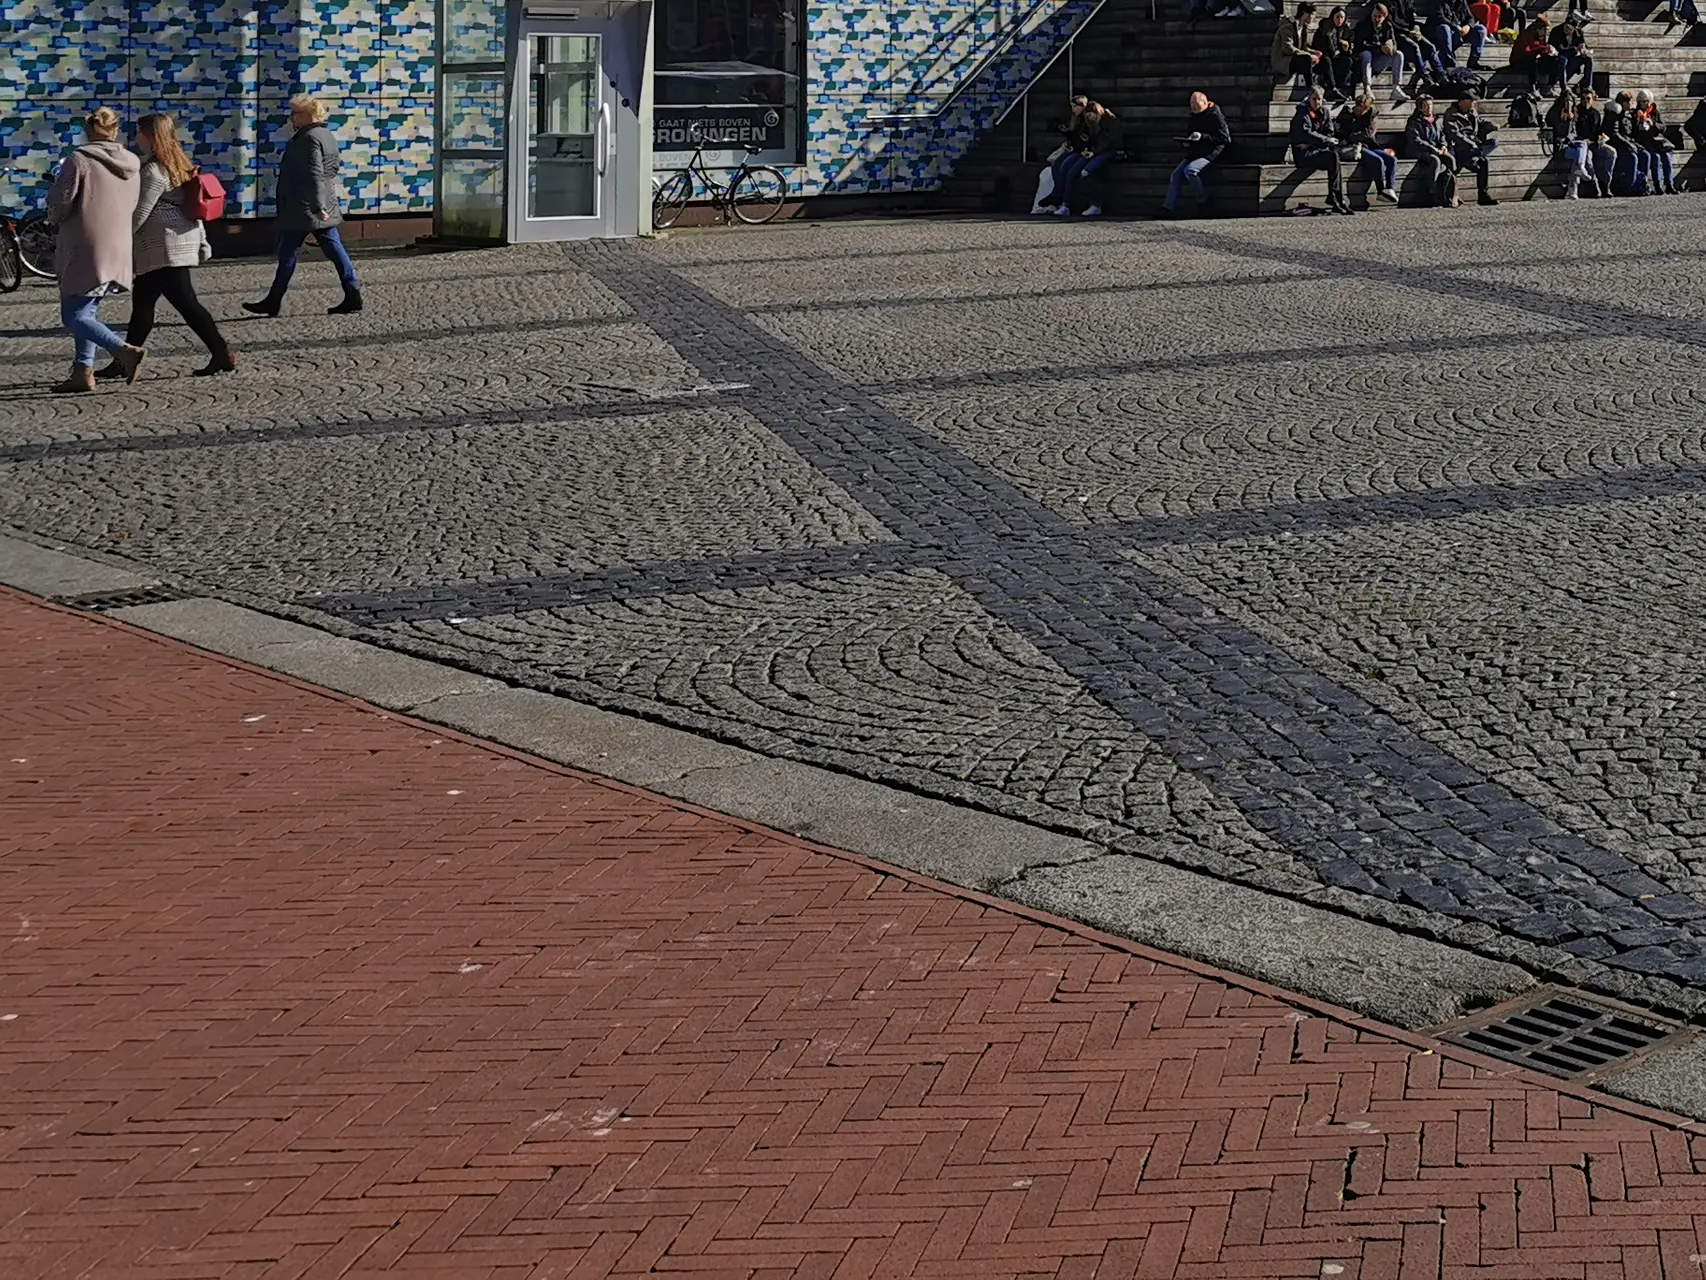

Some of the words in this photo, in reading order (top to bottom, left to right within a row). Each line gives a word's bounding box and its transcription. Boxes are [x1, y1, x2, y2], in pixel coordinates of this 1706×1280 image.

[659, 119, 686, 128] GAAT
[719, 118, 751, 126] BOVEN
[653, 125, 768, 144] RONINGEN
